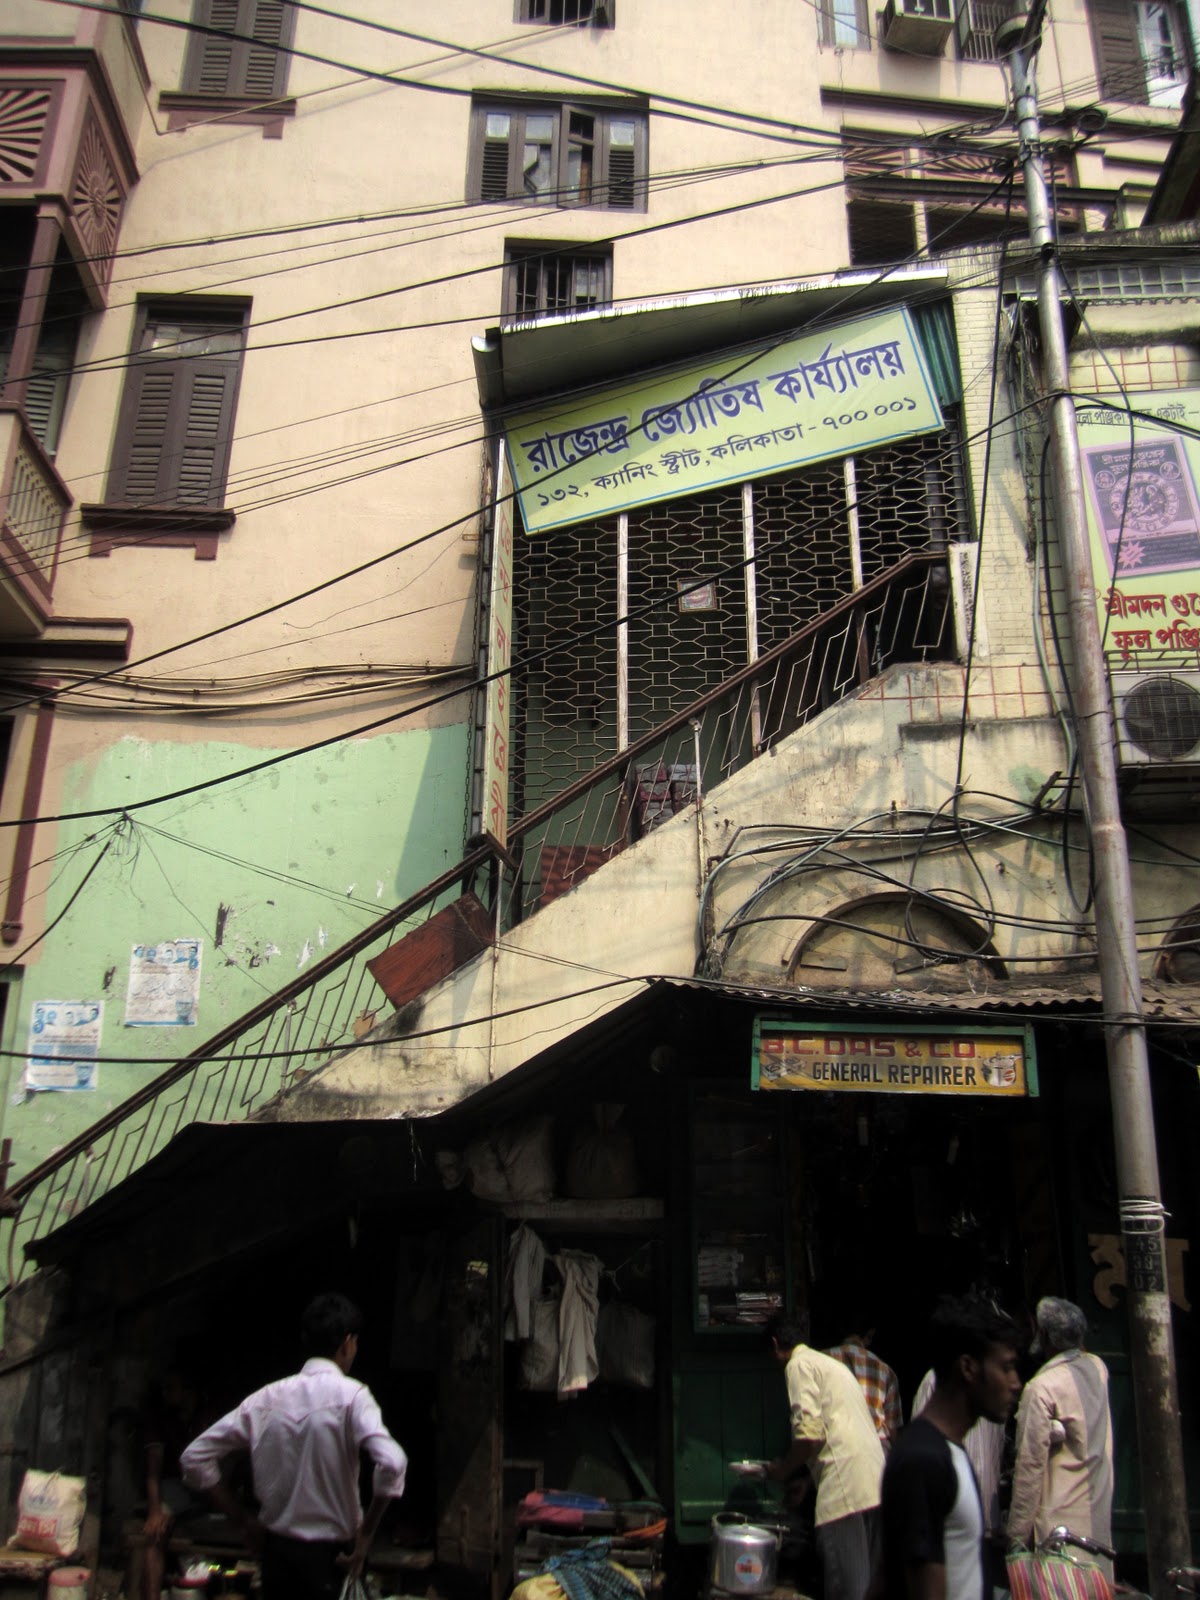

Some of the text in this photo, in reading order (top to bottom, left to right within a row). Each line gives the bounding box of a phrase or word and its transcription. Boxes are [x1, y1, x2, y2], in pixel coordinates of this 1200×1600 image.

[520, 416, 630, 473] রাজেন্দ্র
[641, 377, 765, 442] জ্যোতিষ
[537, 484, 589, 507] ১৩২,
[591, 461, 659, 490] ক্যানিং
[822, 409, 869, 431] ৭০০
[873, 396, 917, 417] ০০১
[1102, 587, 1168, 620] শ্রীমদন
[812, 1061, 977, 1087] GENERAL REPAIRER
